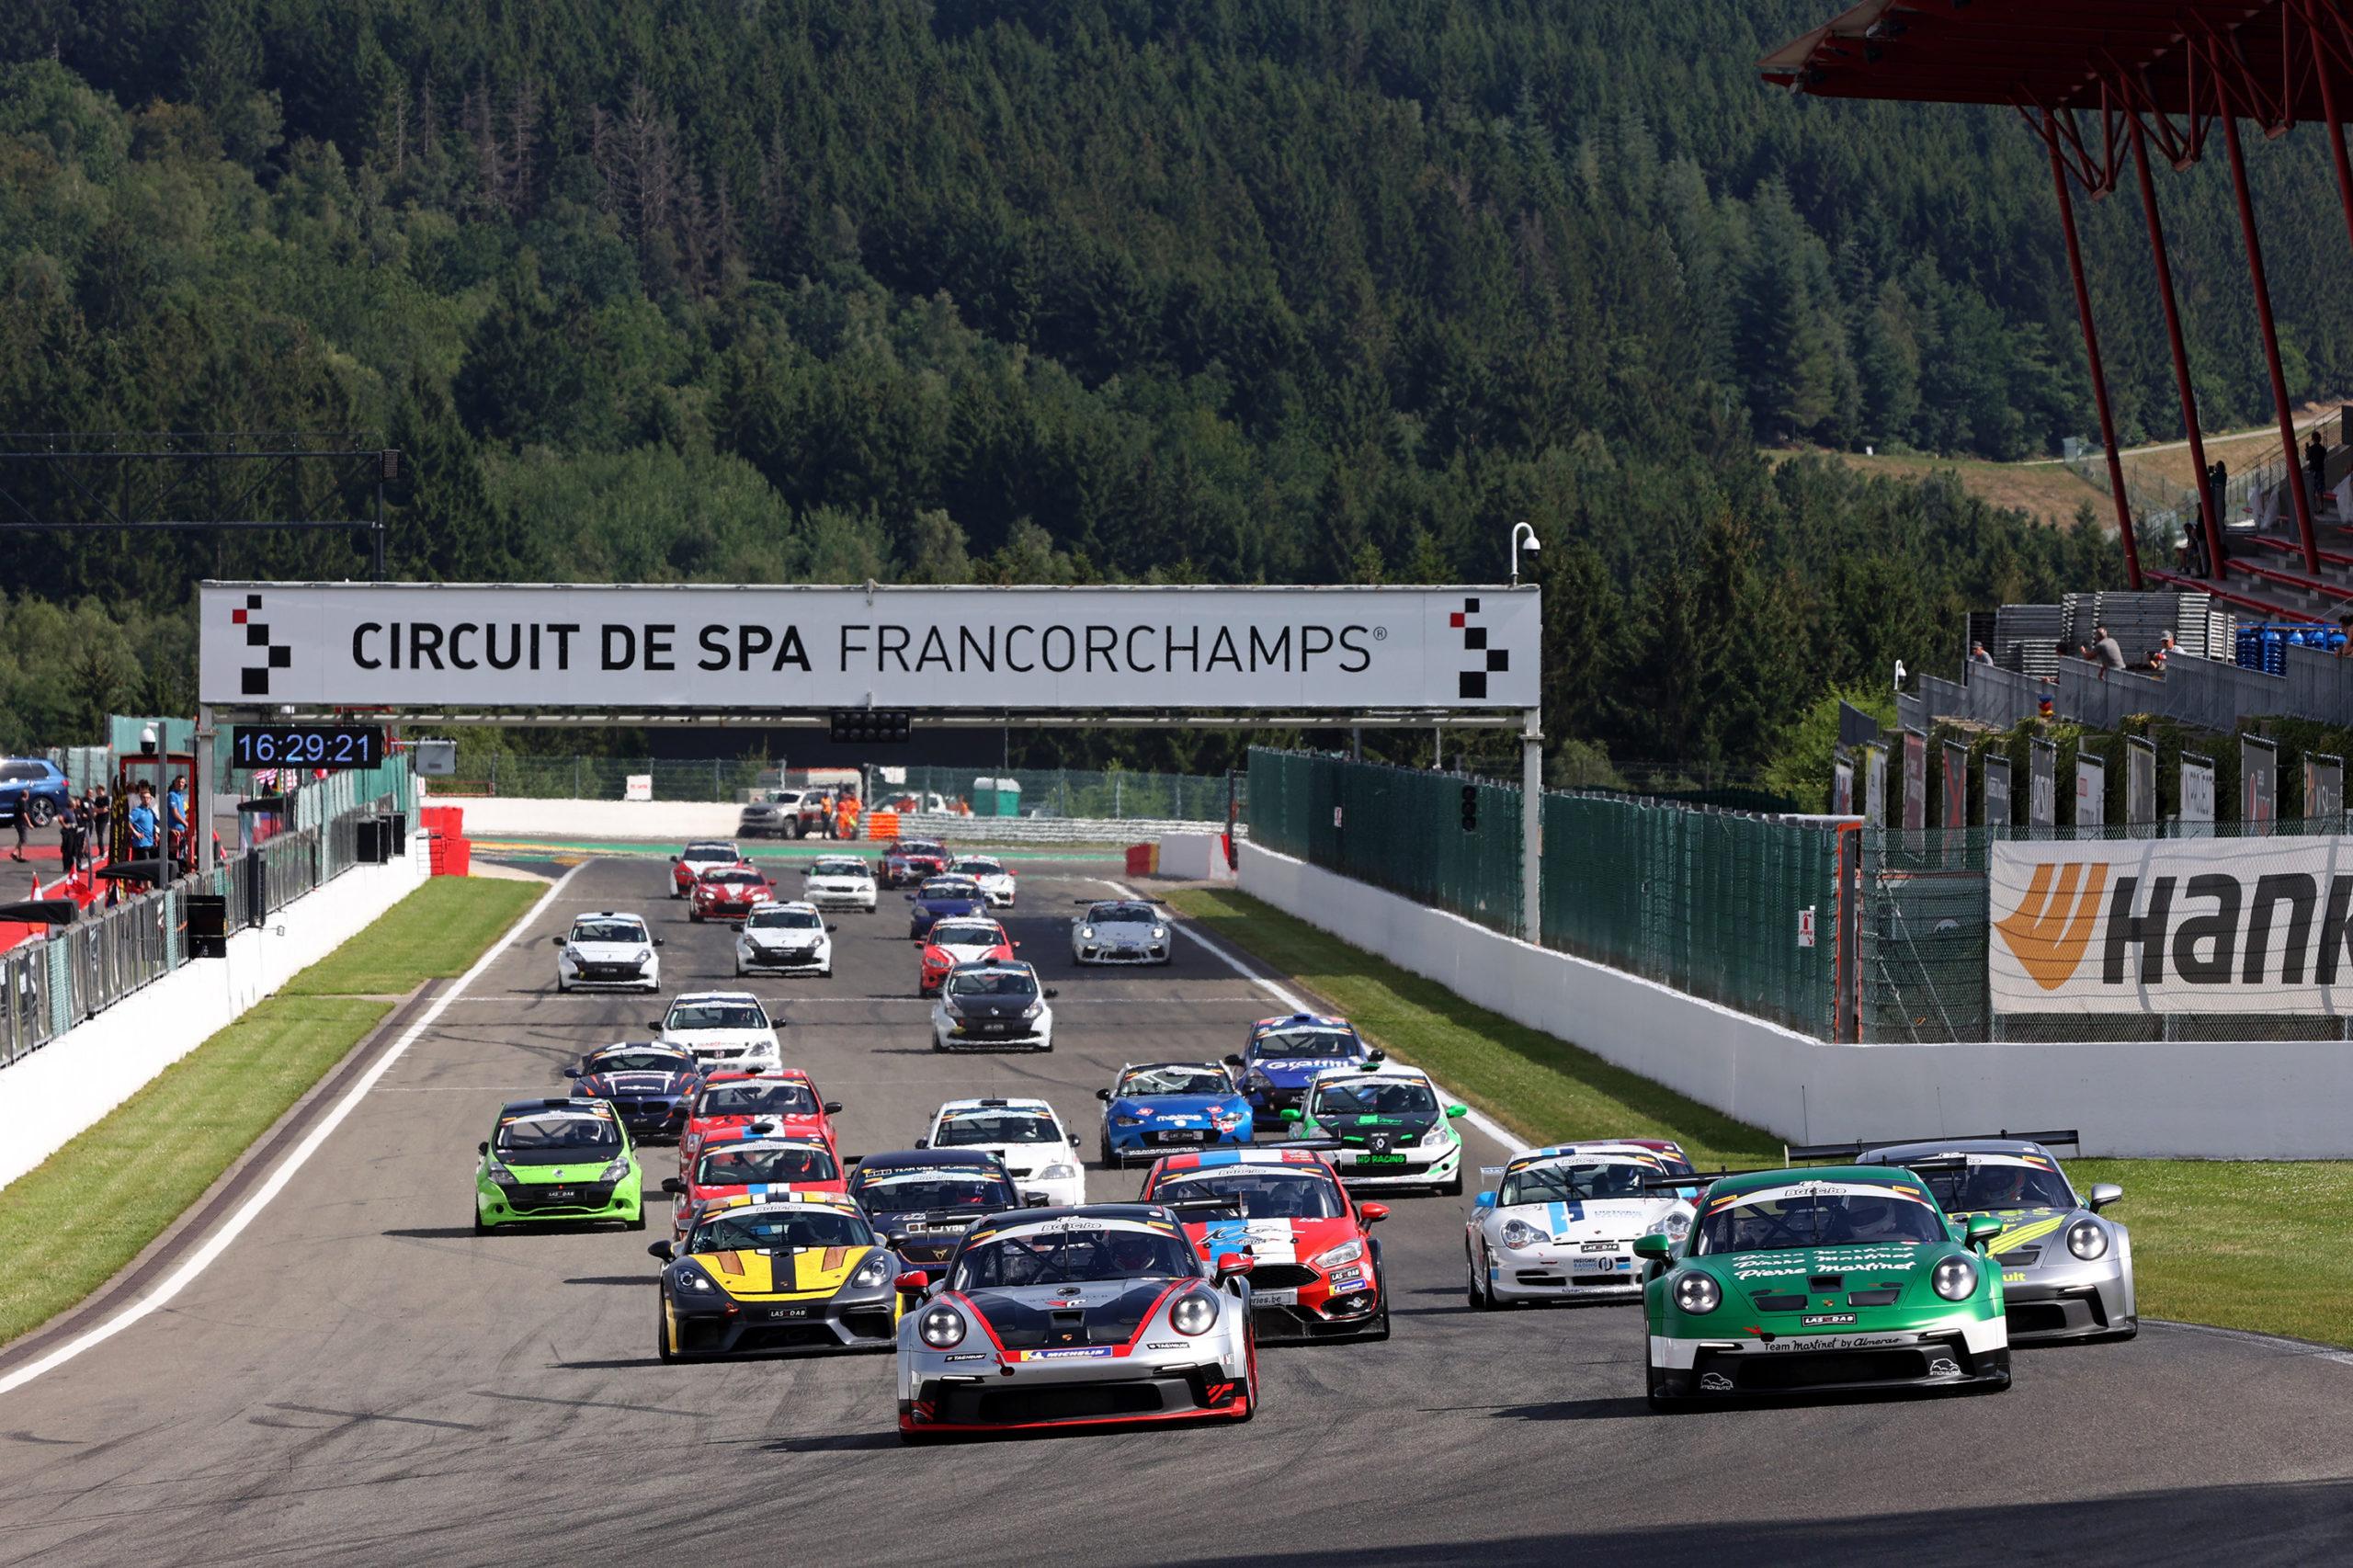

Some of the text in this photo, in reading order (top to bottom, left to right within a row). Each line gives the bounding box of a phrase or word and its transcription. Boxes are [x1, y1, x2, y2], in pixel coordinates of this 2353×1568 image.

[352, 622, 580, 670] CIRCUIT
[602, 624, 676, 671] DE
[699, 624, 813, 672] SPA
[239, 733, 370, 762] 16:29:21
[1356, 1154, 1406, 1165] HD RACING
[1733, 1267, 1807, 1279] Pierre
[1764, 1341, 1790, 1351] Team
[1791, 1337, 1837, 1351] Martinet
[1840, 1338, 1853, 1349] by
